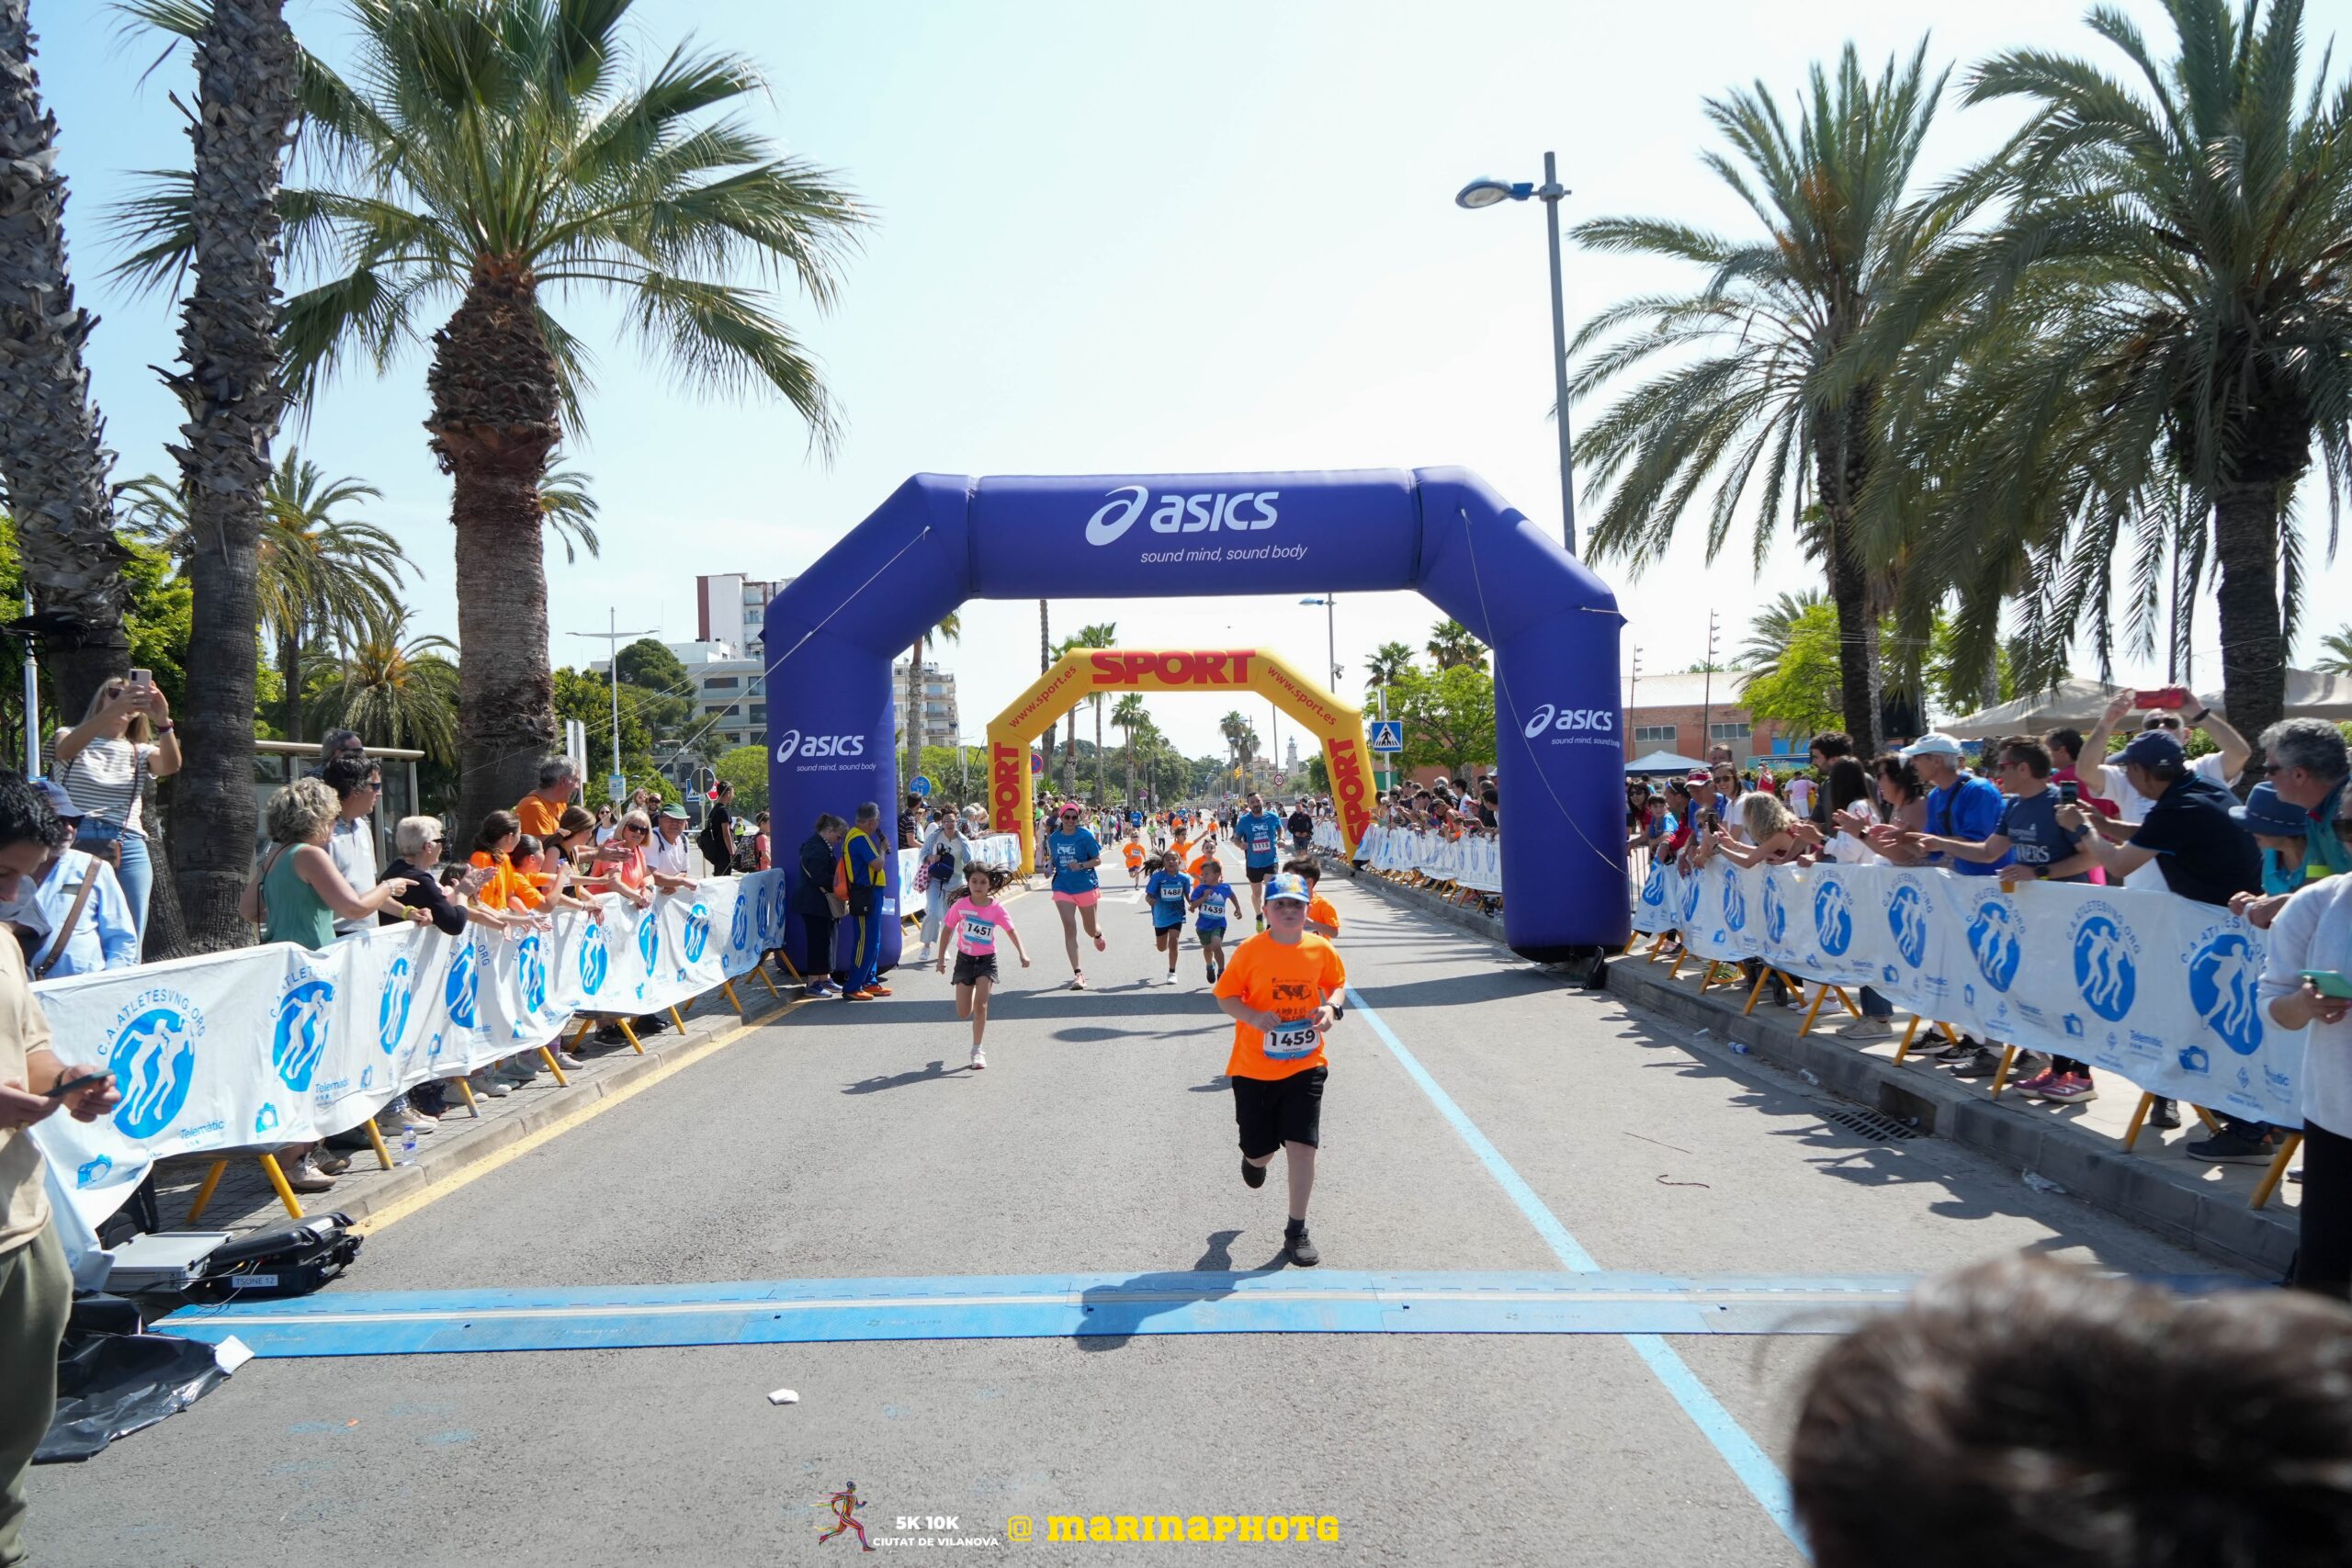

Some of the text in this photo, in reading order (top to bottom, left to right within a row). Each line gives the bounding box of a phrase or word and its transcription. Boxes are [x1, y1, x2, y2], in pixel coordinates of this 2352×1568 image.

[1140, 544, 1307, 563] sound mind, sound body
[1091, 649, 1256, 684] SPORT
[1009, 665, 1077, 728] www.sport.es
[1268, 666, 1338, 726] www.sport.es
[1551, 737, 1574, 745] sound
[861, 762, 876, 772] body
[1204, 904, 1223, 914] 1439
[967, 923, 991, 936] 1451
[1271, 1029, 1316, 1046] 1459
